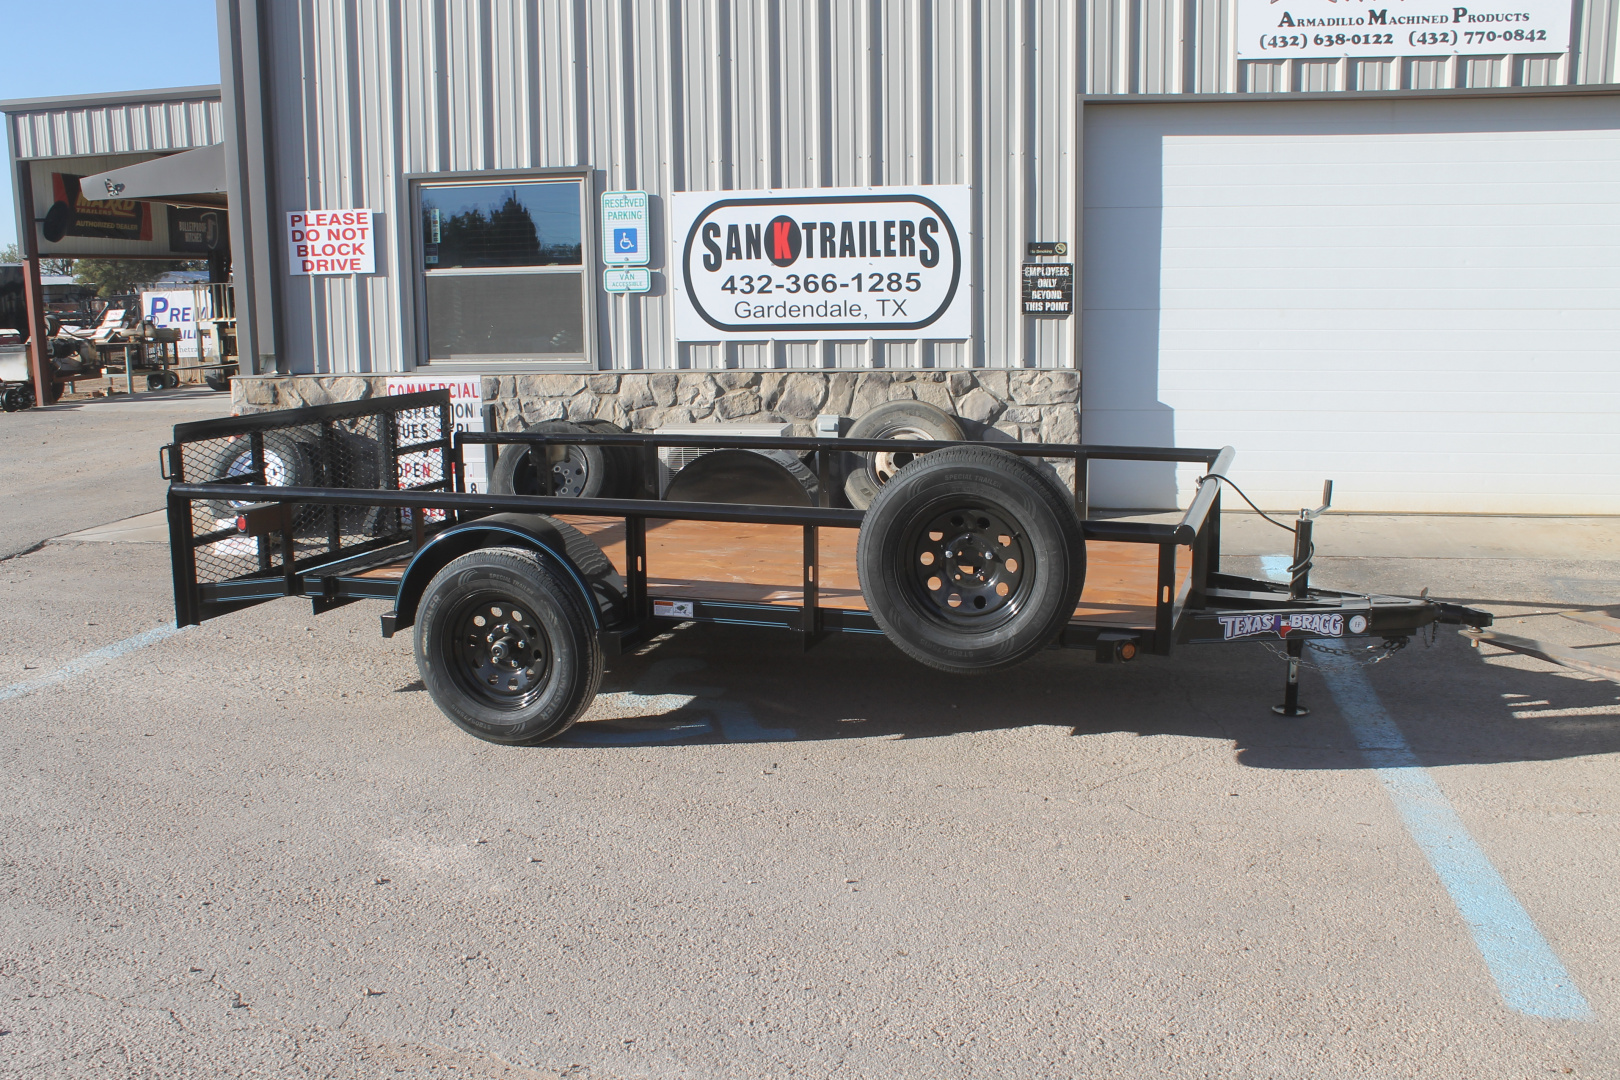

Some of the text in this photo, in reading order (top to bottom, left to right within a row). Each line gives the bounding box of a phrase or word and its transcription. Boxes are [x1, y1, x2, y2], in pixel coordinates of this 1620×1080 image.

[1278, 7, 1530, 27] ARMADILLO MACHINED PRODUCTS
[1259, 29, 1547, 49] (432) 638-0122 (432) 770-0842
[605, 198, 645, 208] RESERVED
[76, 207, 112, 216] TRAILERS
[608, 210, 642, 220] PARKING
[75, 220, 138, 231] AUTHORIZED DEALER
[290, 212, 368, 227] PLEASE
[291, 227, 369, 243] DO NOT
[296, 243, 365, 257] BLOCK
[301, 258, 361, 272] DRIVE
[1025, 266, 1069, 276] EMPLOYEES
[721, 272, 922, 295] 432-366-1285
[1037, 278, 1057, 288] ONLY
[1031, 290, 1062, 299] BEYOND
[734, 299, 908, 319] Gardendale, TX
[1025, 302, 1069, 311] THIS POINT
[944, 473, 973, 481] SPECIAL
[1219, 614, 1343, 640] TEXAS BRAGG
